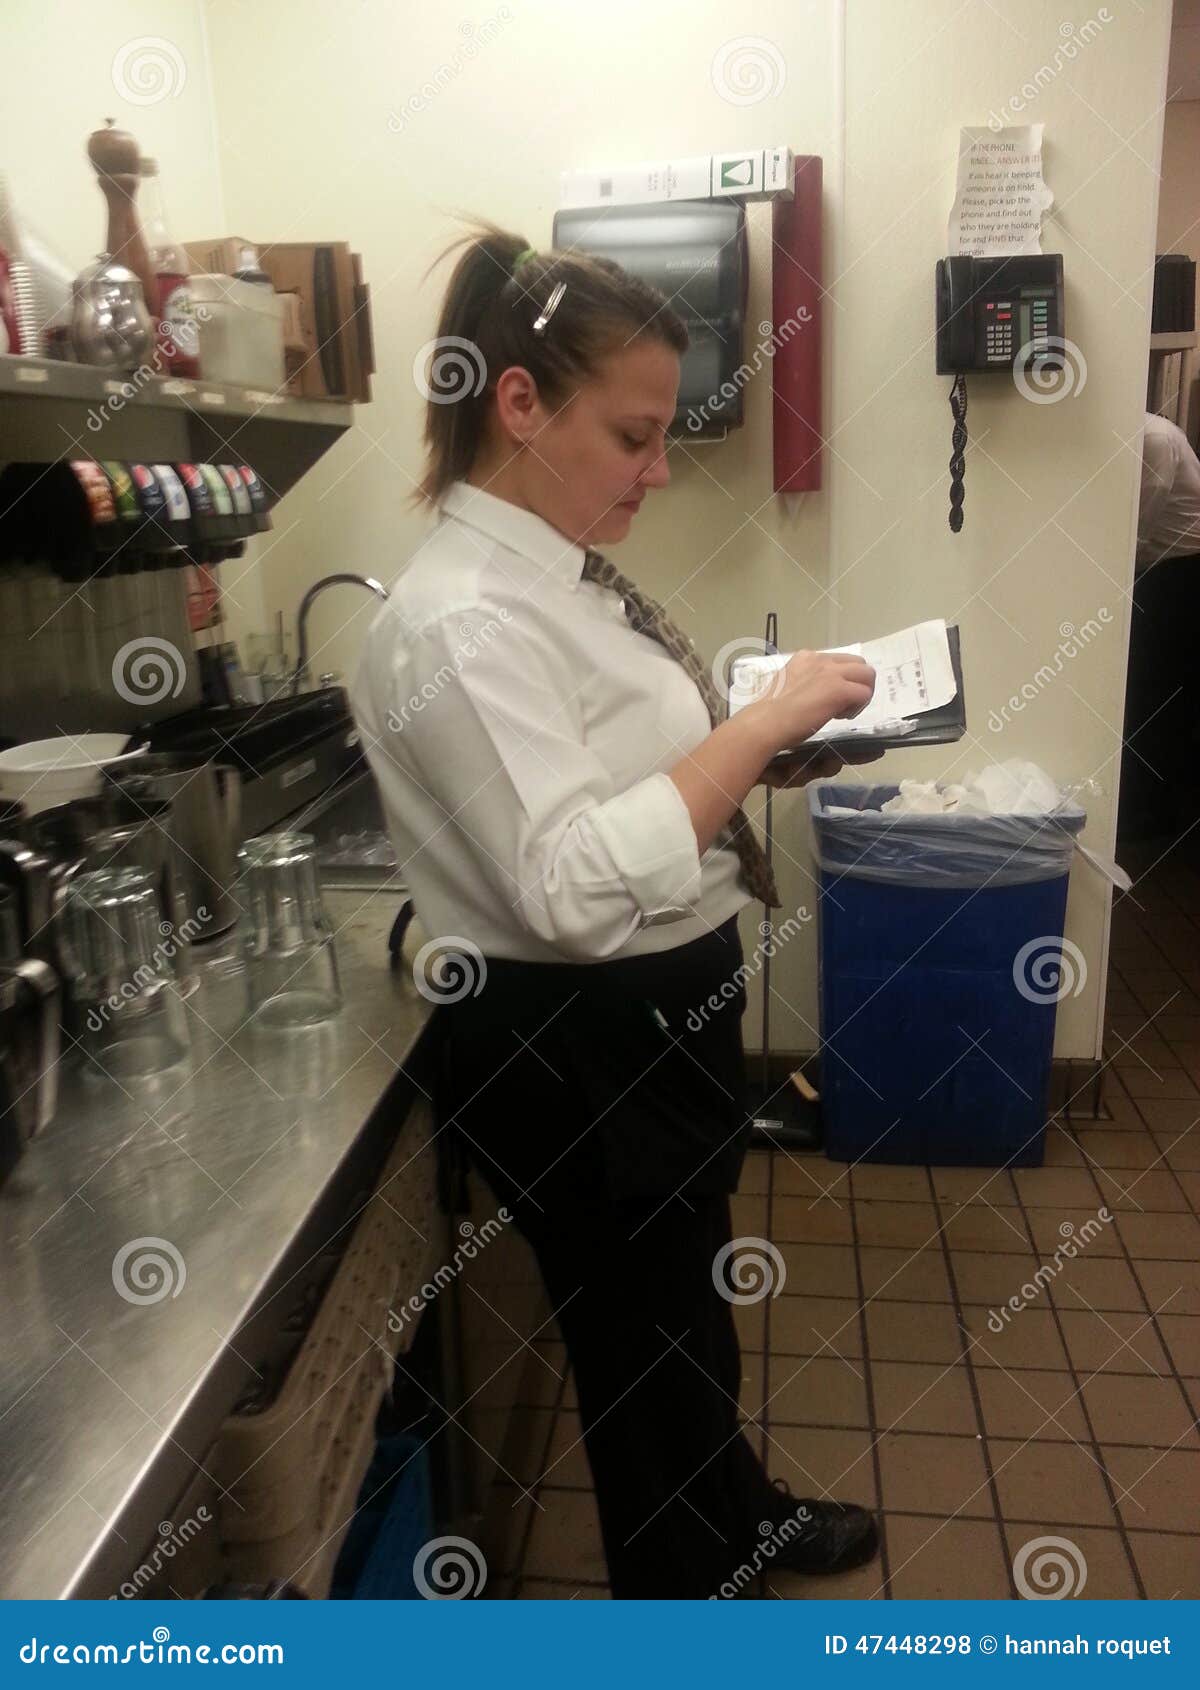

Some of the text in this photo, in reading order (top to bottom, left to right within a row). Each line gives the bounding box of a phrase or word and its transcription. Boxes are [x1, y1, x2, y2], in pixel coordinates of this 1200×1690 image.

[1011, 170, 1041, 180] beeping
[997, 184, 1005, 192] is
[1005, 184, 1016, 192] on
[988, 197, 1004, 206] pick
[1005, 198, 1017, 206] up
[1017, 196, 1031, 204] the
[960, 209, 1032, 219] phone and find out
[960, 223, 977, 231] who
[977, 223, 995, 232] they
[1010, 221, 1040, 231] holding
[959, 235, 1024, 244] for and FIND that
